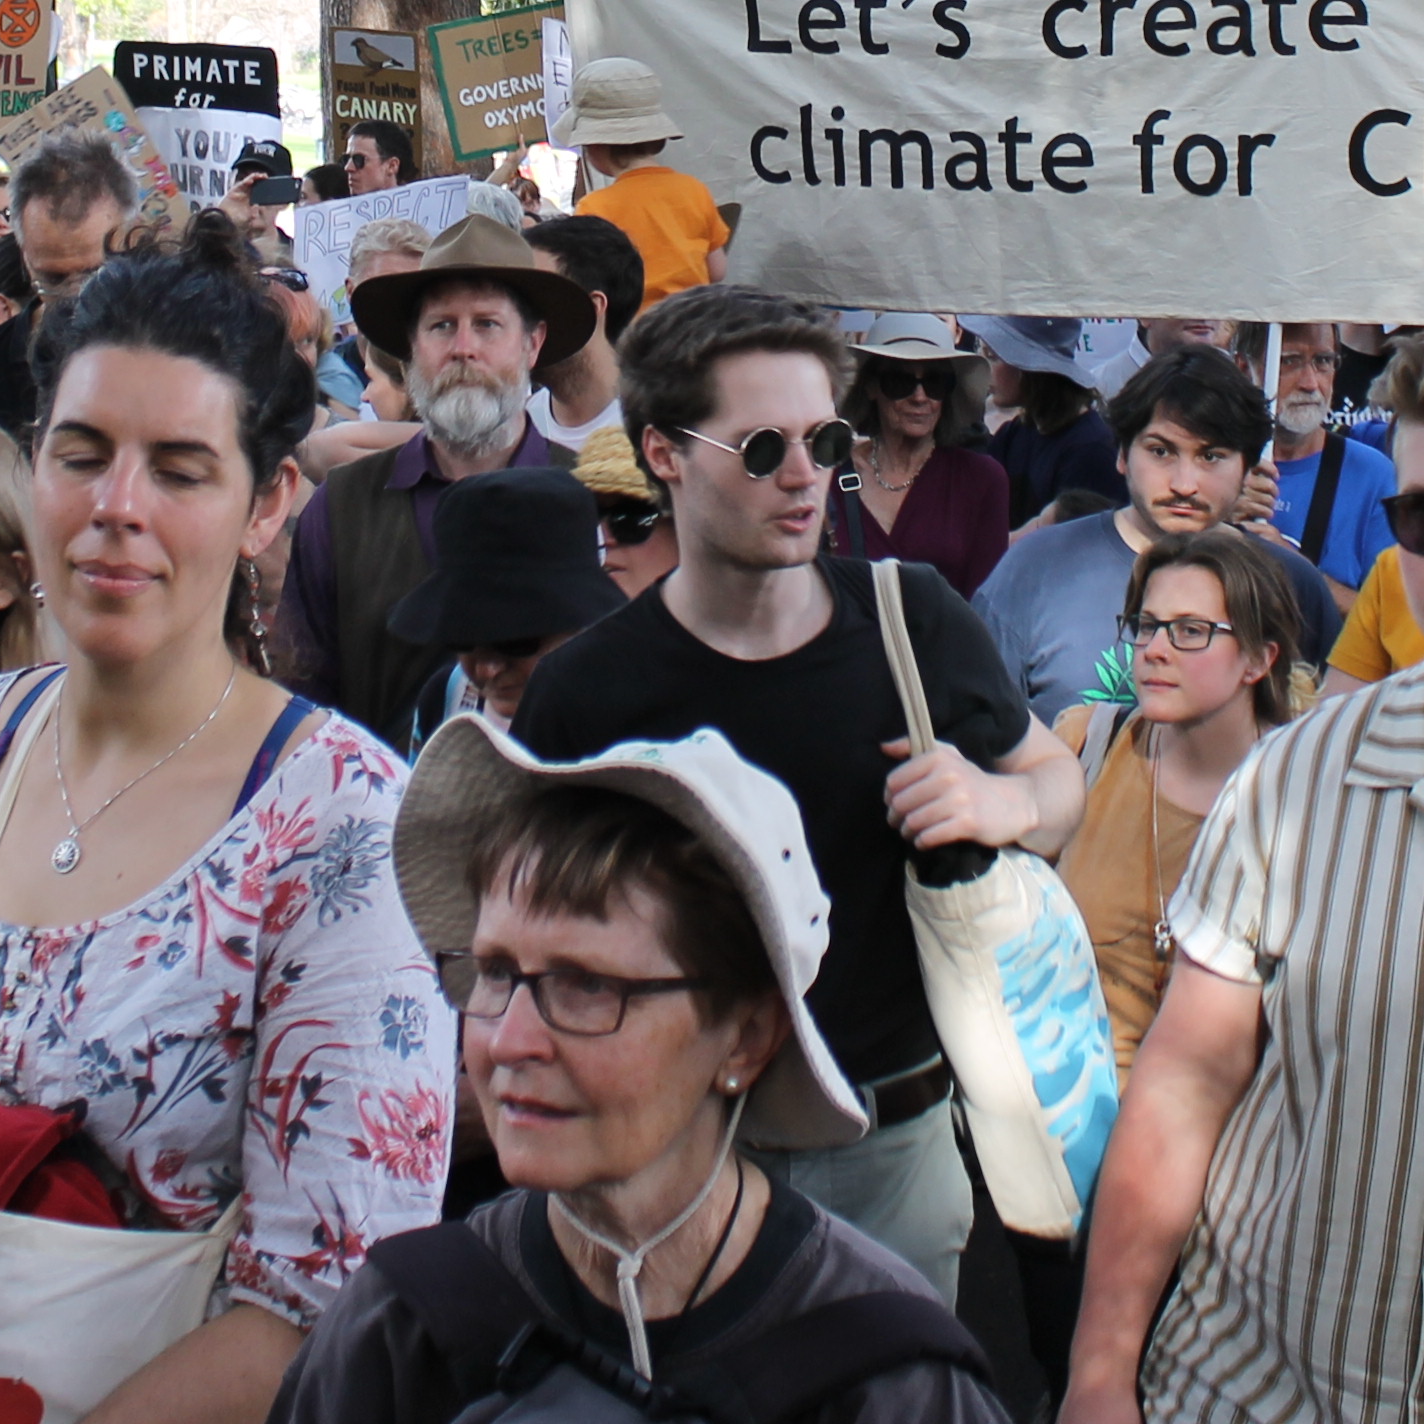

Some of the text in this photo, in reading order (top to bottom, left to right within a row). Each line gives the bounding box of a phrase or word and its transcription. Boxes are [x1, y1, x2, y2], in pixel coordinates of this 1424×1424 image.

[133, 53, 261, 86] PRIMATE
[174, 88, 216, 109] for
[336, 95, 417, 125] CANARY
[484, 98, 546, 128] OXYMO
[750, 103, 1094, 194] climate
[1132, 109, 1276, 197] for
